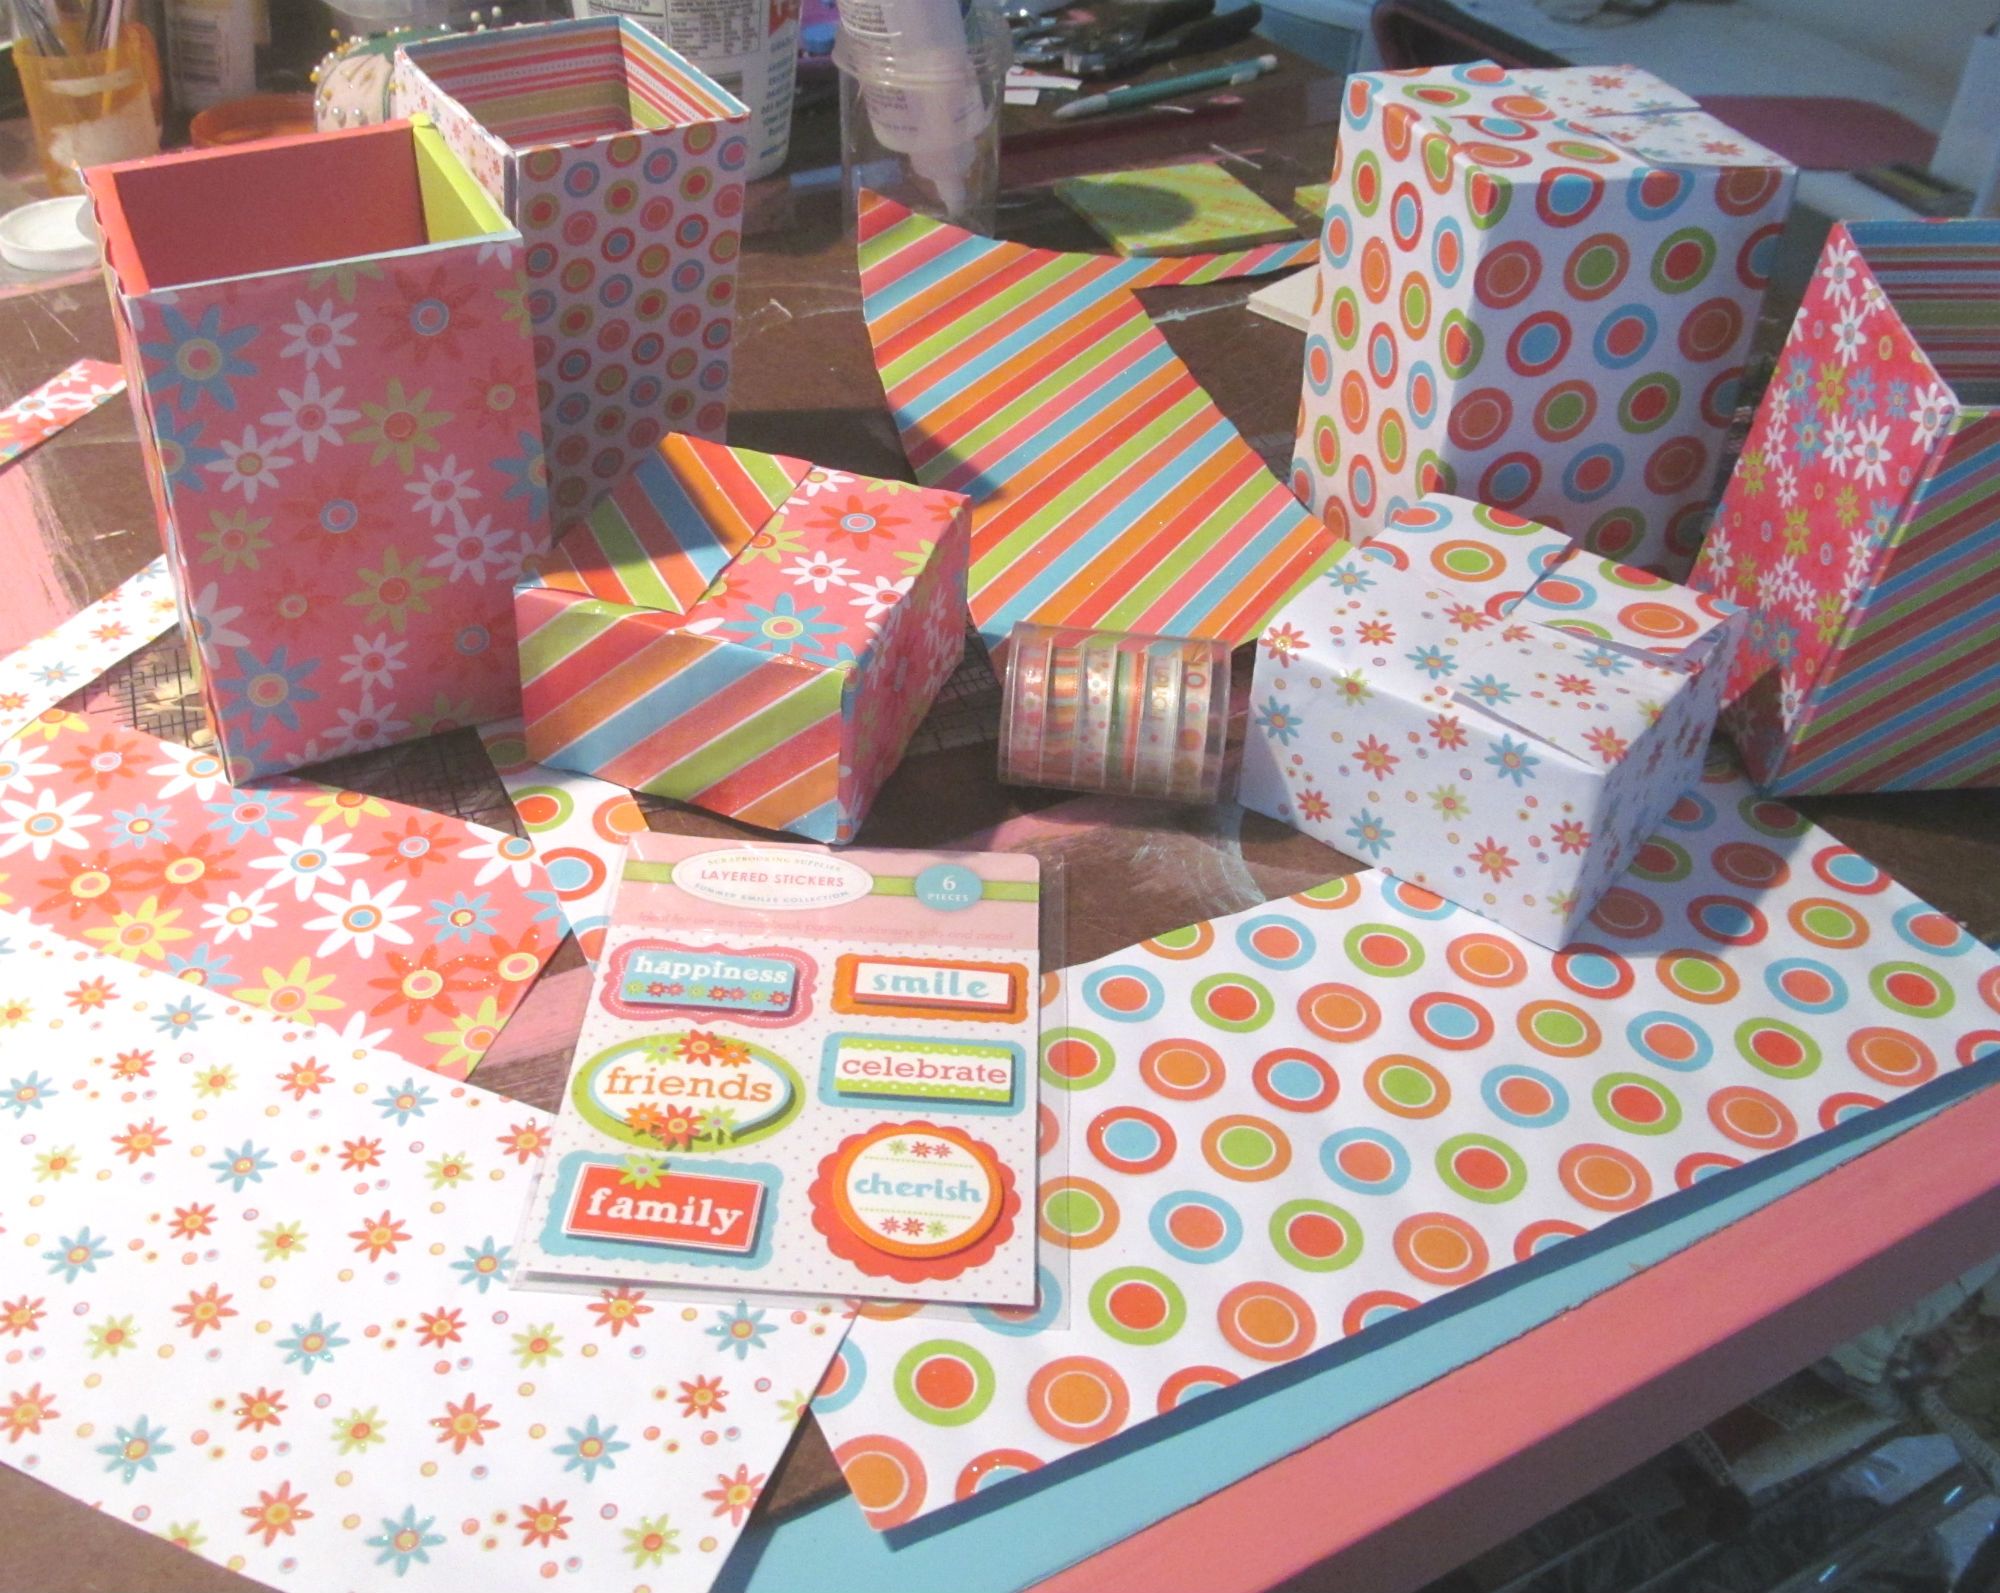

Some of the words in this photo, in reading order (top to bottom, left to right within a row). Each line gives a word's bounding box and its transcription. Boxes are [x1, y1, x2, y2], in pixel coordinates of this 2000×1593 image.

[701, 870, 769, 884] LAYERED
[774, 874, 845, 888] STICKERS
[942, 874, 957, 891] 6
[783, 889, 850, 904] COLLECTION
[927, 893, 969, 903] PIECES
[634, 955, 788, 984] happiness
[872, 971, 990, 999] smile
[603, 1065, 773, 1103] friends
[842, 1056, 1007, 1084] celebrate
[854, 1172, 983, 1203] cherish
[586, 1187, 744, 1236] family
